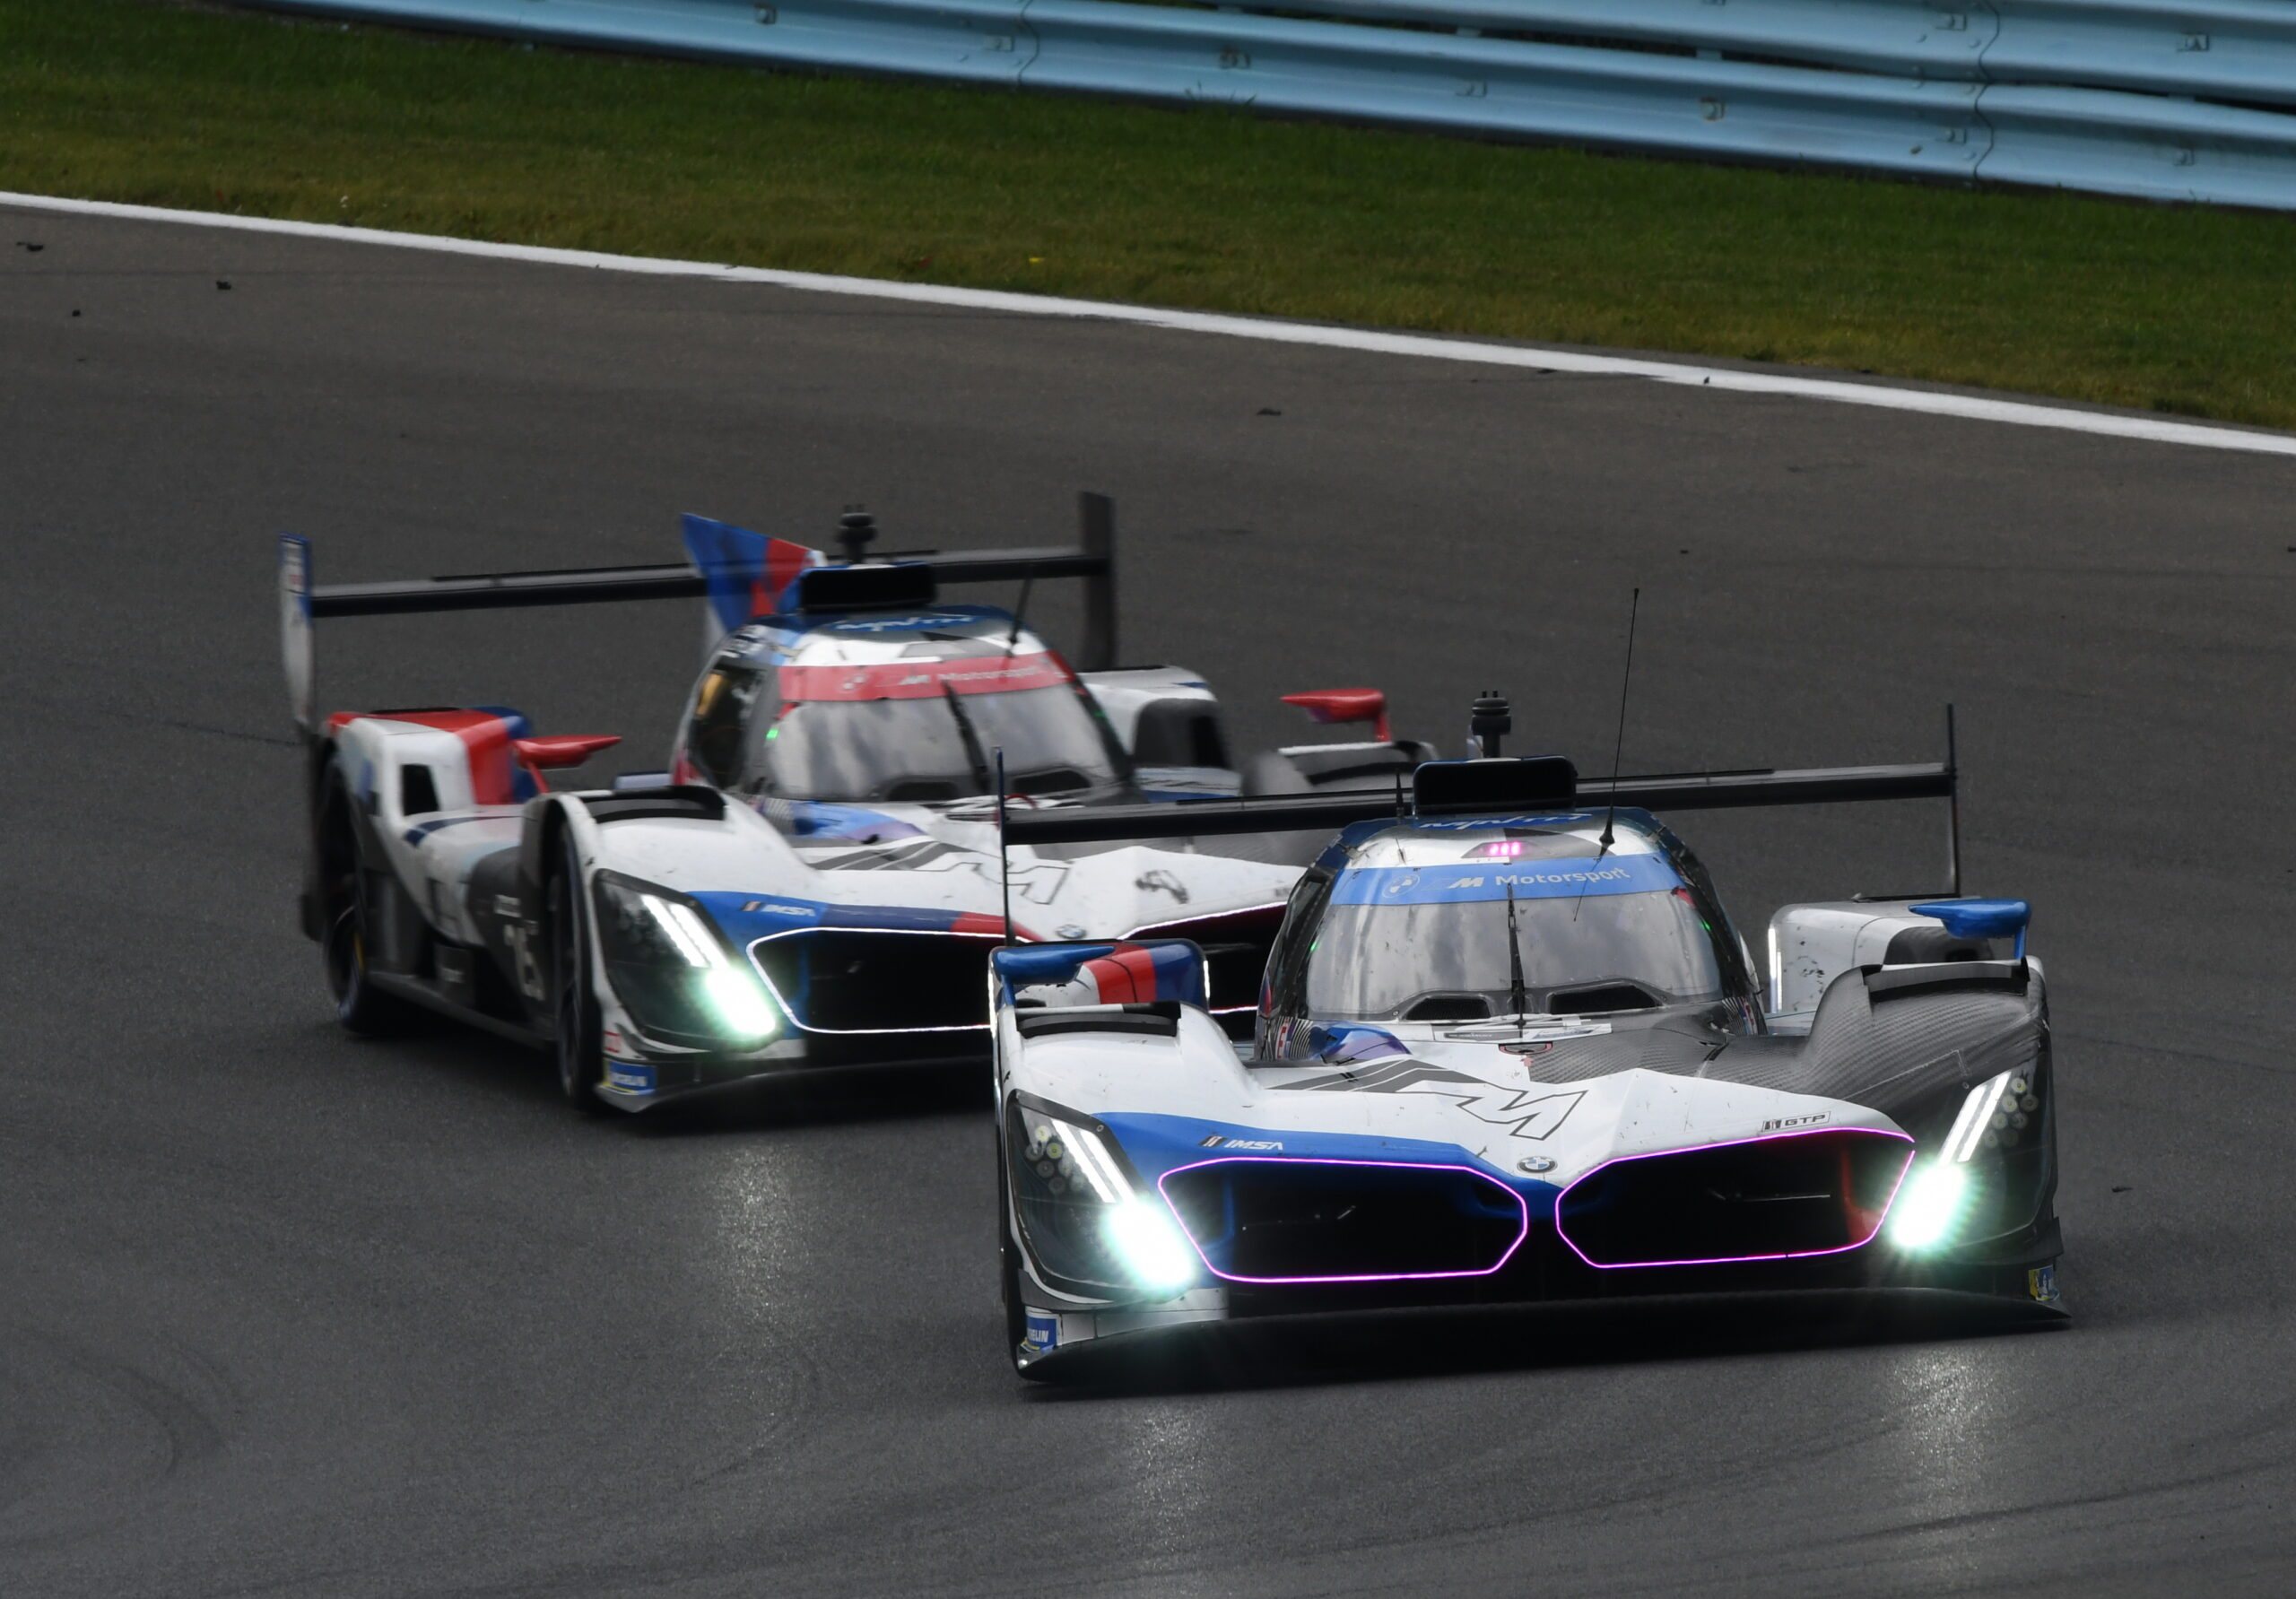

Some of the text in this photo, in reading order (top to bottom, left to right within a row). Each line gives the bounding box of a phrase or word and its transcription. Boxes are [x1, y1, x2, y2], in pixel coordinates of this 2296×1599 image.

[1496, 867, 1631, 886] Motorsport
[1785, 1114, 1826, 1126] GTP
[1223, 1139, 1283, 1151] IMSA
